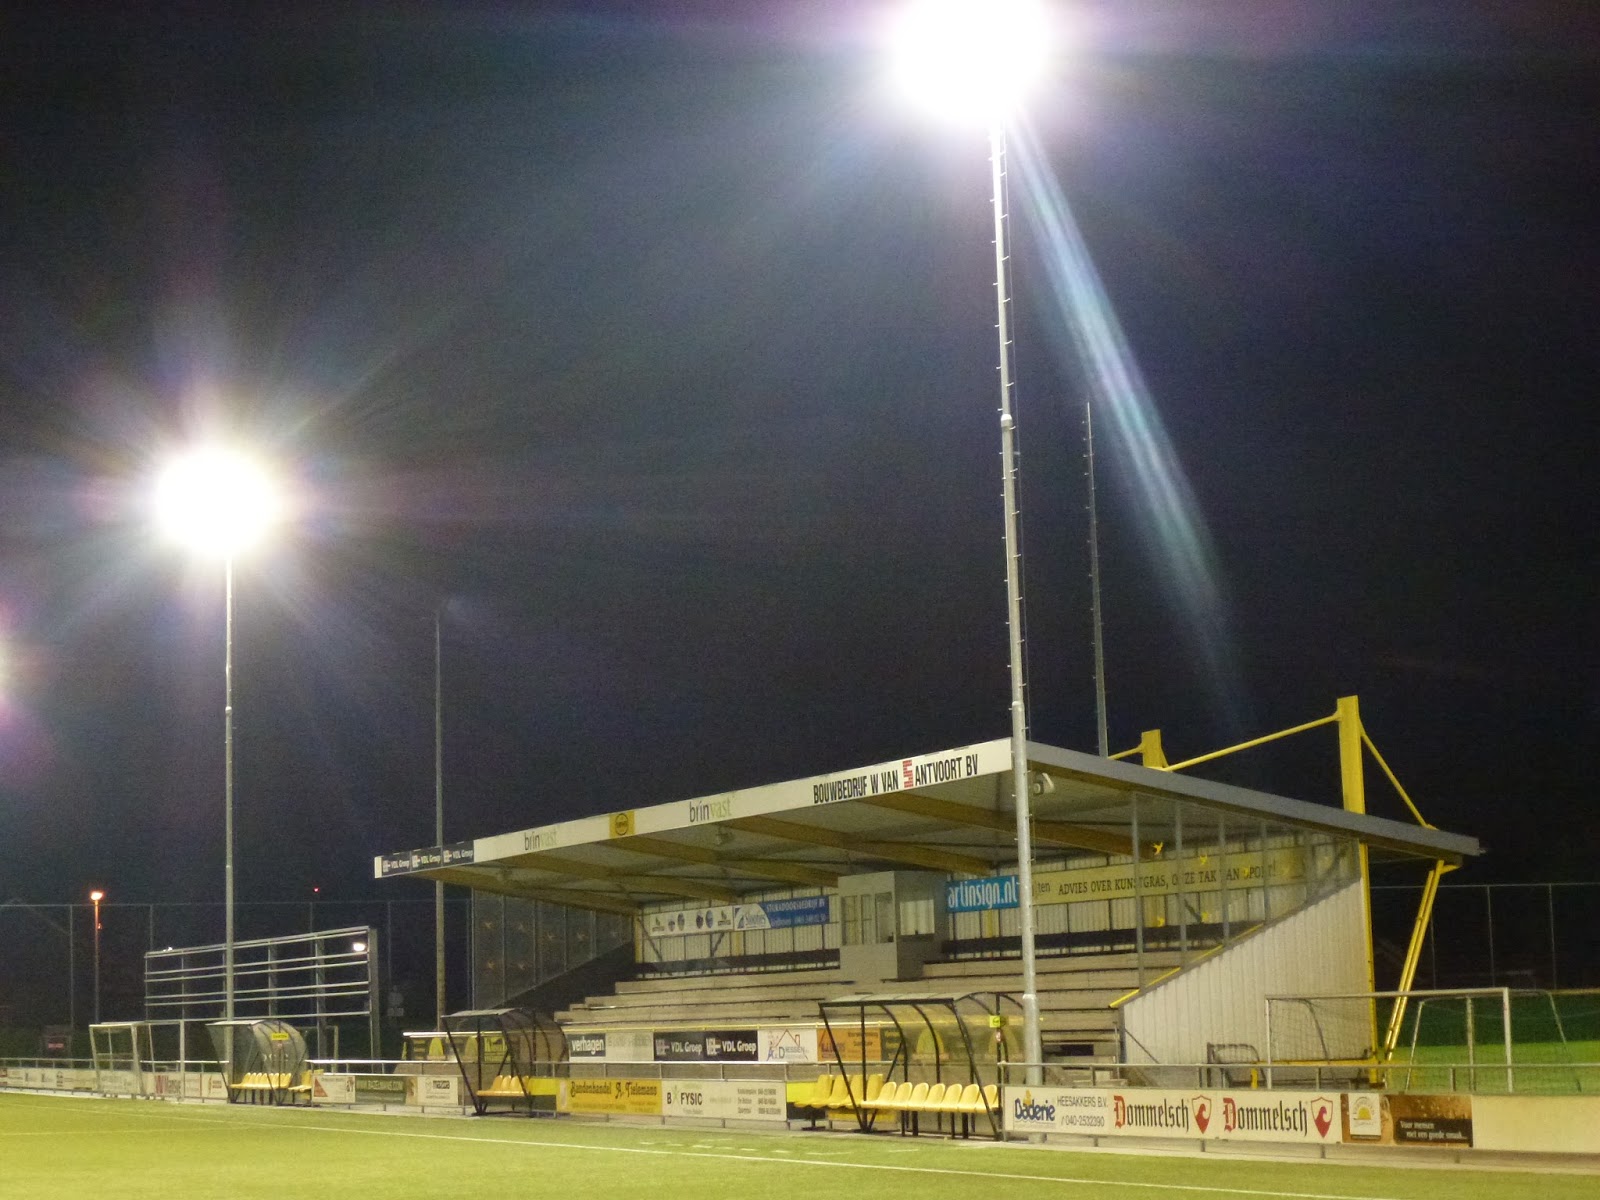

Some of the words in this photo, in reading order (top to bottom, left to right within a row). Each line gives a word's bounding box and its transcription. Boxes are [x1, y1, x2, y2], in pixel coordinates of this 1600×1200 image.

[813, 775, 867, 804] BOUWBEDRIJF
[870, 773, 879, 794] W
[881, 769, 899, 792] VAN
[965, 753, 978, 777] BV
[947, 875, 1018, 910] artinsign.nl
[1058, 881, 1088, 896] ADVIES
[1090, 880, 1113, 893] OVER
[1198, 870, 1217, 883] TAK
[571, 1035, 605, 1055] verhagen
[670, 1041, 684, 1053] VDL
[684, 1041, 703, 1056] Groep
[721, 1040, 736, 1053] VDL
[736, 1040, 757, 1055] Groep
[680, 1092, 703, 1106] FYSIC
[1057, 1095, 1096, 1107] HEESAKKERS
[1113, 1095, 1189, 1133] Dommelsch
[1222, 1097, 1308, 1138] Dommelsch
